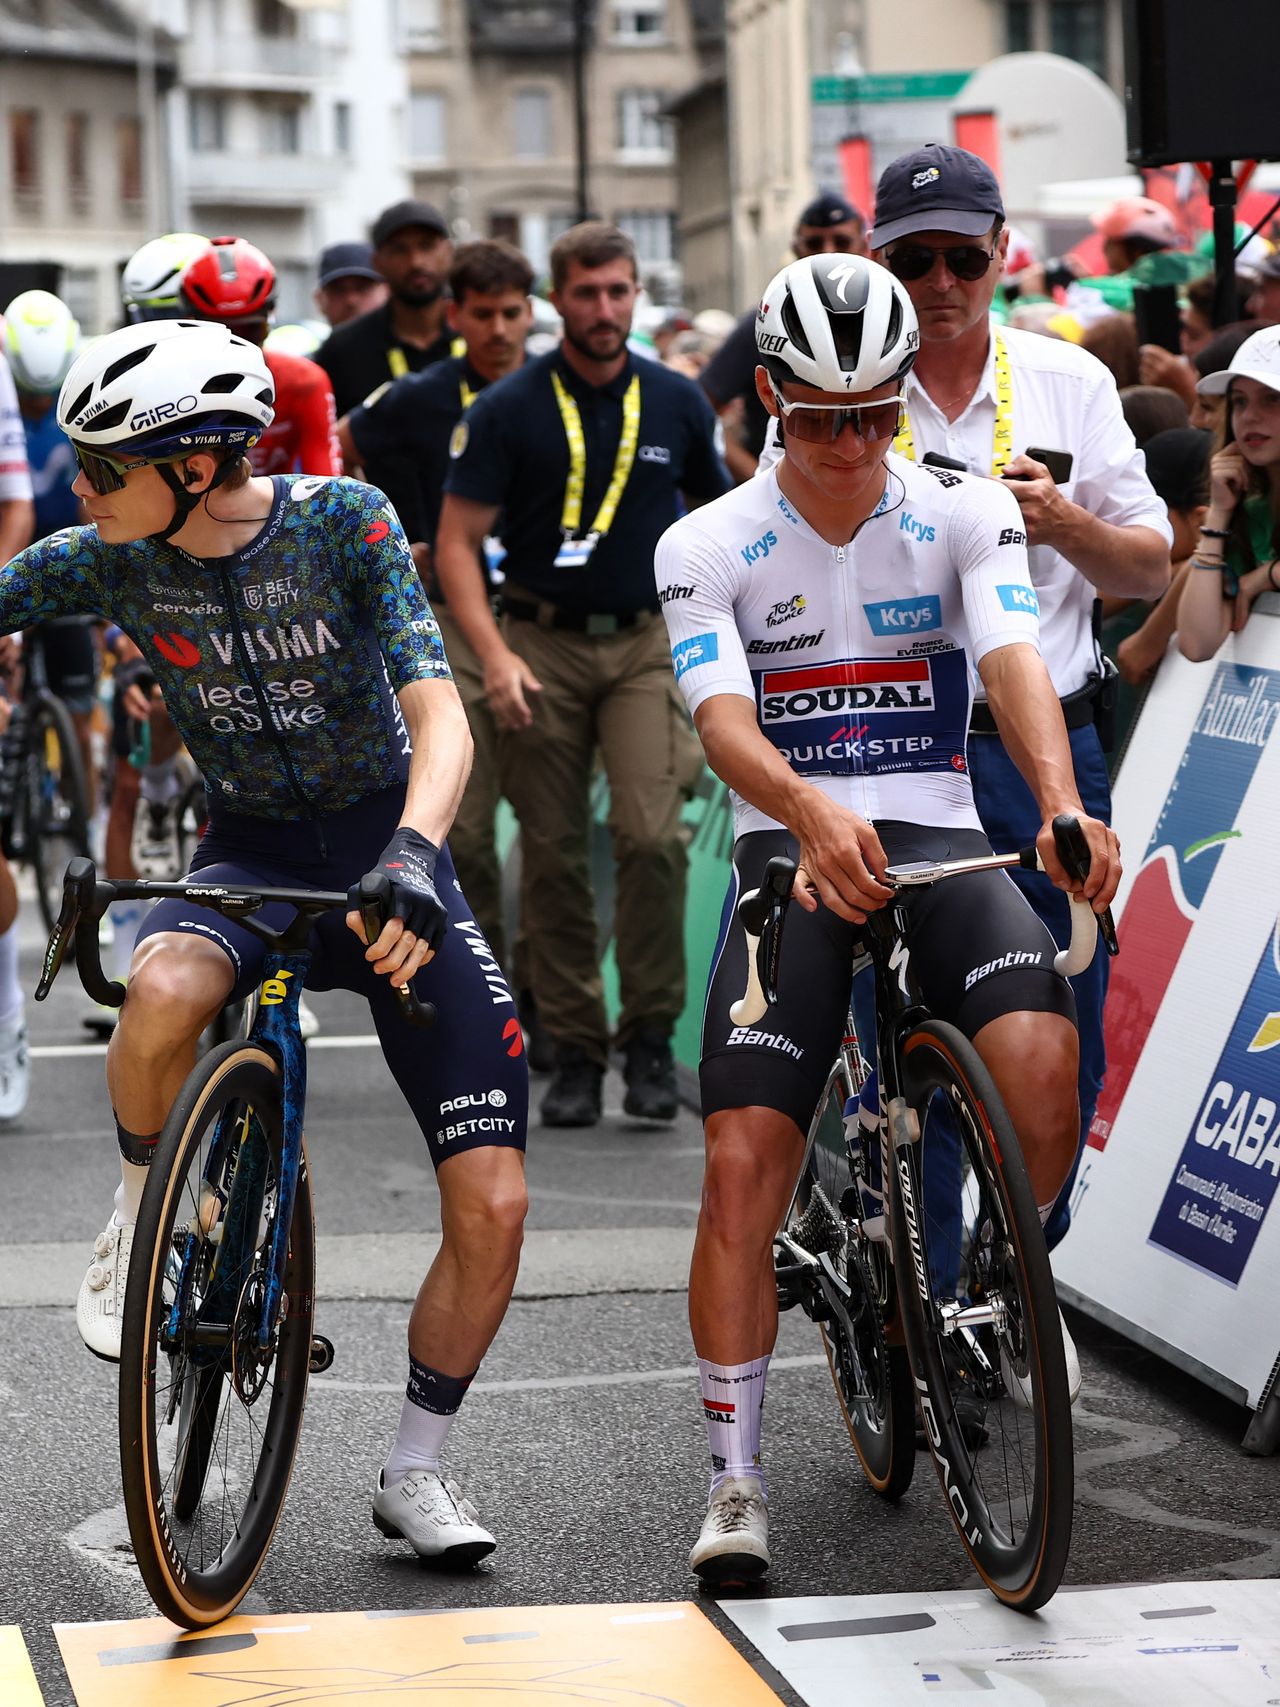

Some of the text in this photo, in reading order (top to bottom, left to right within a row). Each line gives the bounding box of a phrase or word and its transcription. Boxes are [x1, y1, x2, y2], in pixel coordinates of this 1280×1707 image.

[83, 399, 110, 420] VISMA
[130, 395, 198, 432] GIRO
[195, 435, 221, 444] VISMA
[777, 500, 799, 524] Krys
[899, 511, 936, 542] Krys
[741, 530, 778, 566] Krys
[265, 577, 293, 592] BET
[658, 584, 696, 605] ntini
[268, 588, 299, 607] CITY
[880, 604, 933, 629] Krys
[210, 620, 341, 664] VISMA
[747, 629, 825, 654] Santini
[897, 643, 956, 656] EVENEPOEL
[912, 639, 944, 648] Remco
[674, 643, 704, 670] rys
[197, 679, 315, 708] lease
[764, 685, 932, 720] SOUDAL
[454, 920, 513, 1005] VISMA
[965, 950, 1043, 992] Santini
[726, 1027, 805, 1060] Santini
[439, 1094, 487, 1116] AGU
[446, 1117, 516, 1141] BETCITY
[899, 1160, 929, 1300] SPECIALIZED
